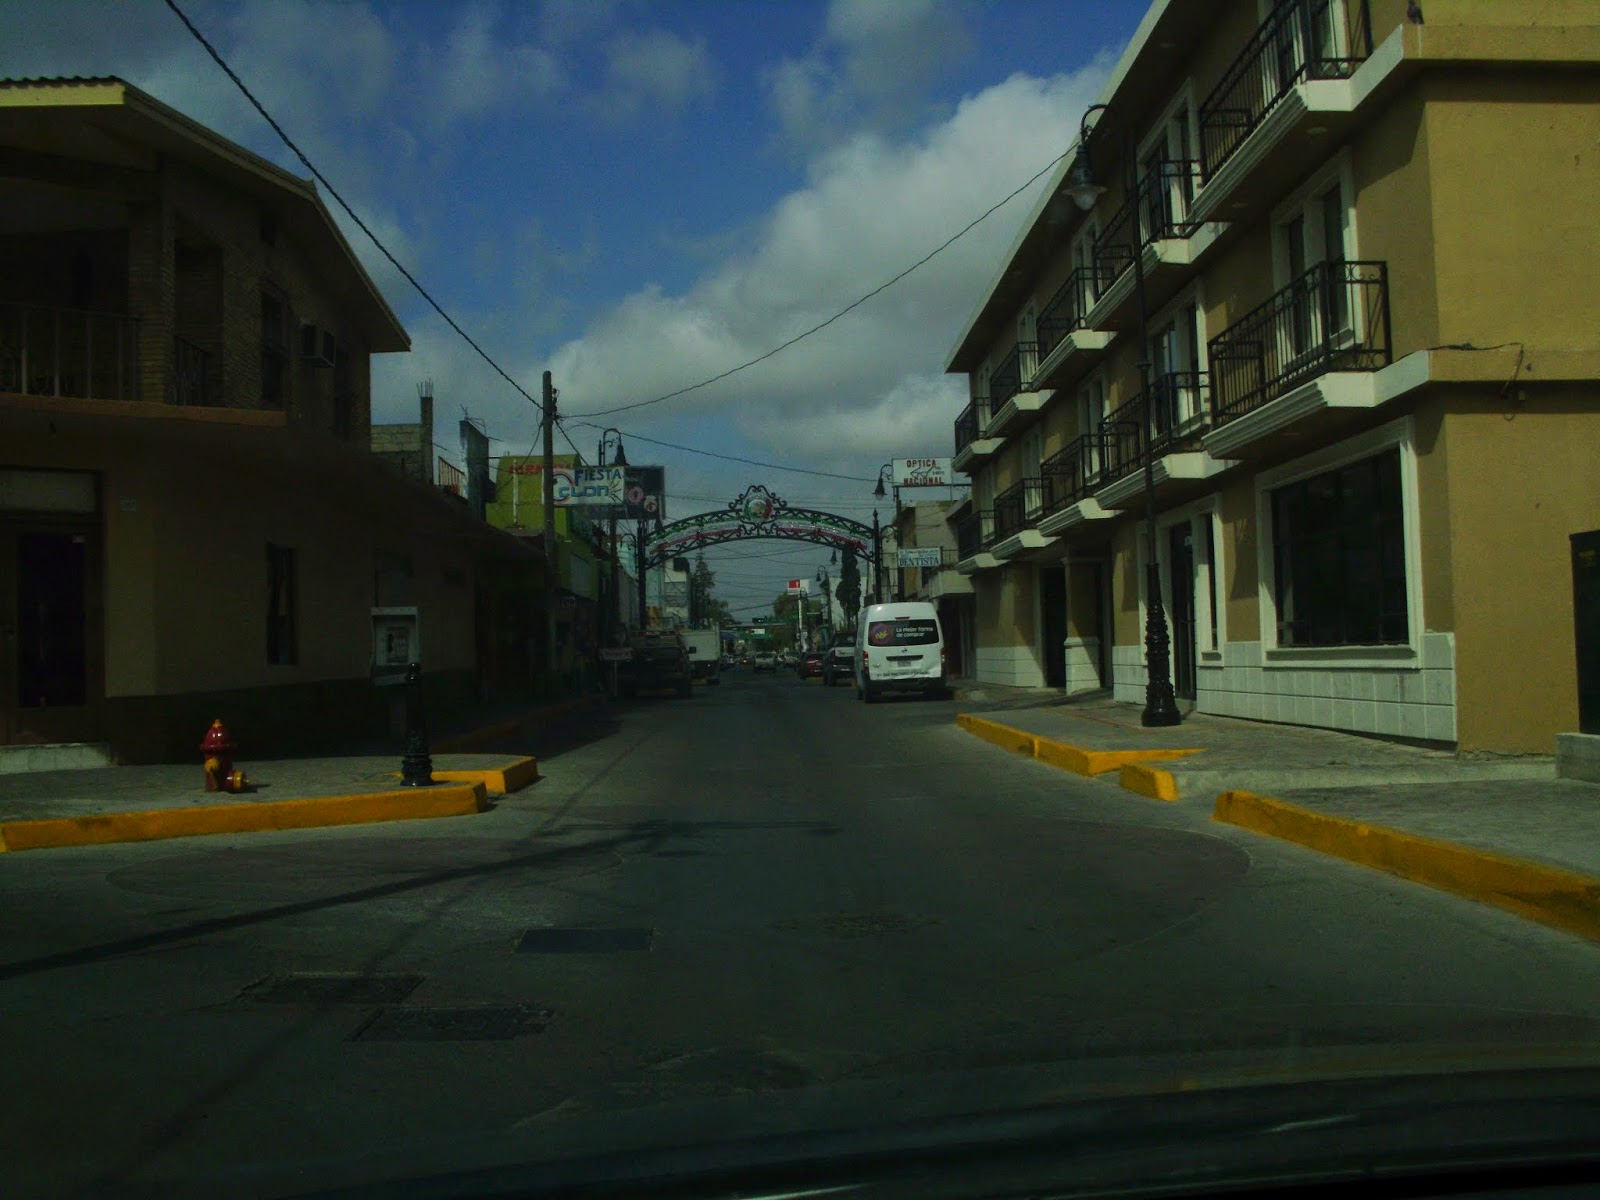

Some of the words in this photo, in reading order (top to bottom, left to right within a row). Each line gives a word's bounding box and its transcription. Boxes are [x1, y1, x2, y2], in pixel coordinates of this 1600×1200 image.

[906, 459, 937, 468] OPTICA
[574, 468, 622, 486] FIESTA
[903, 476, 944, 486] NACIONAL
[899, 556, 939, 566] DENTISTA
